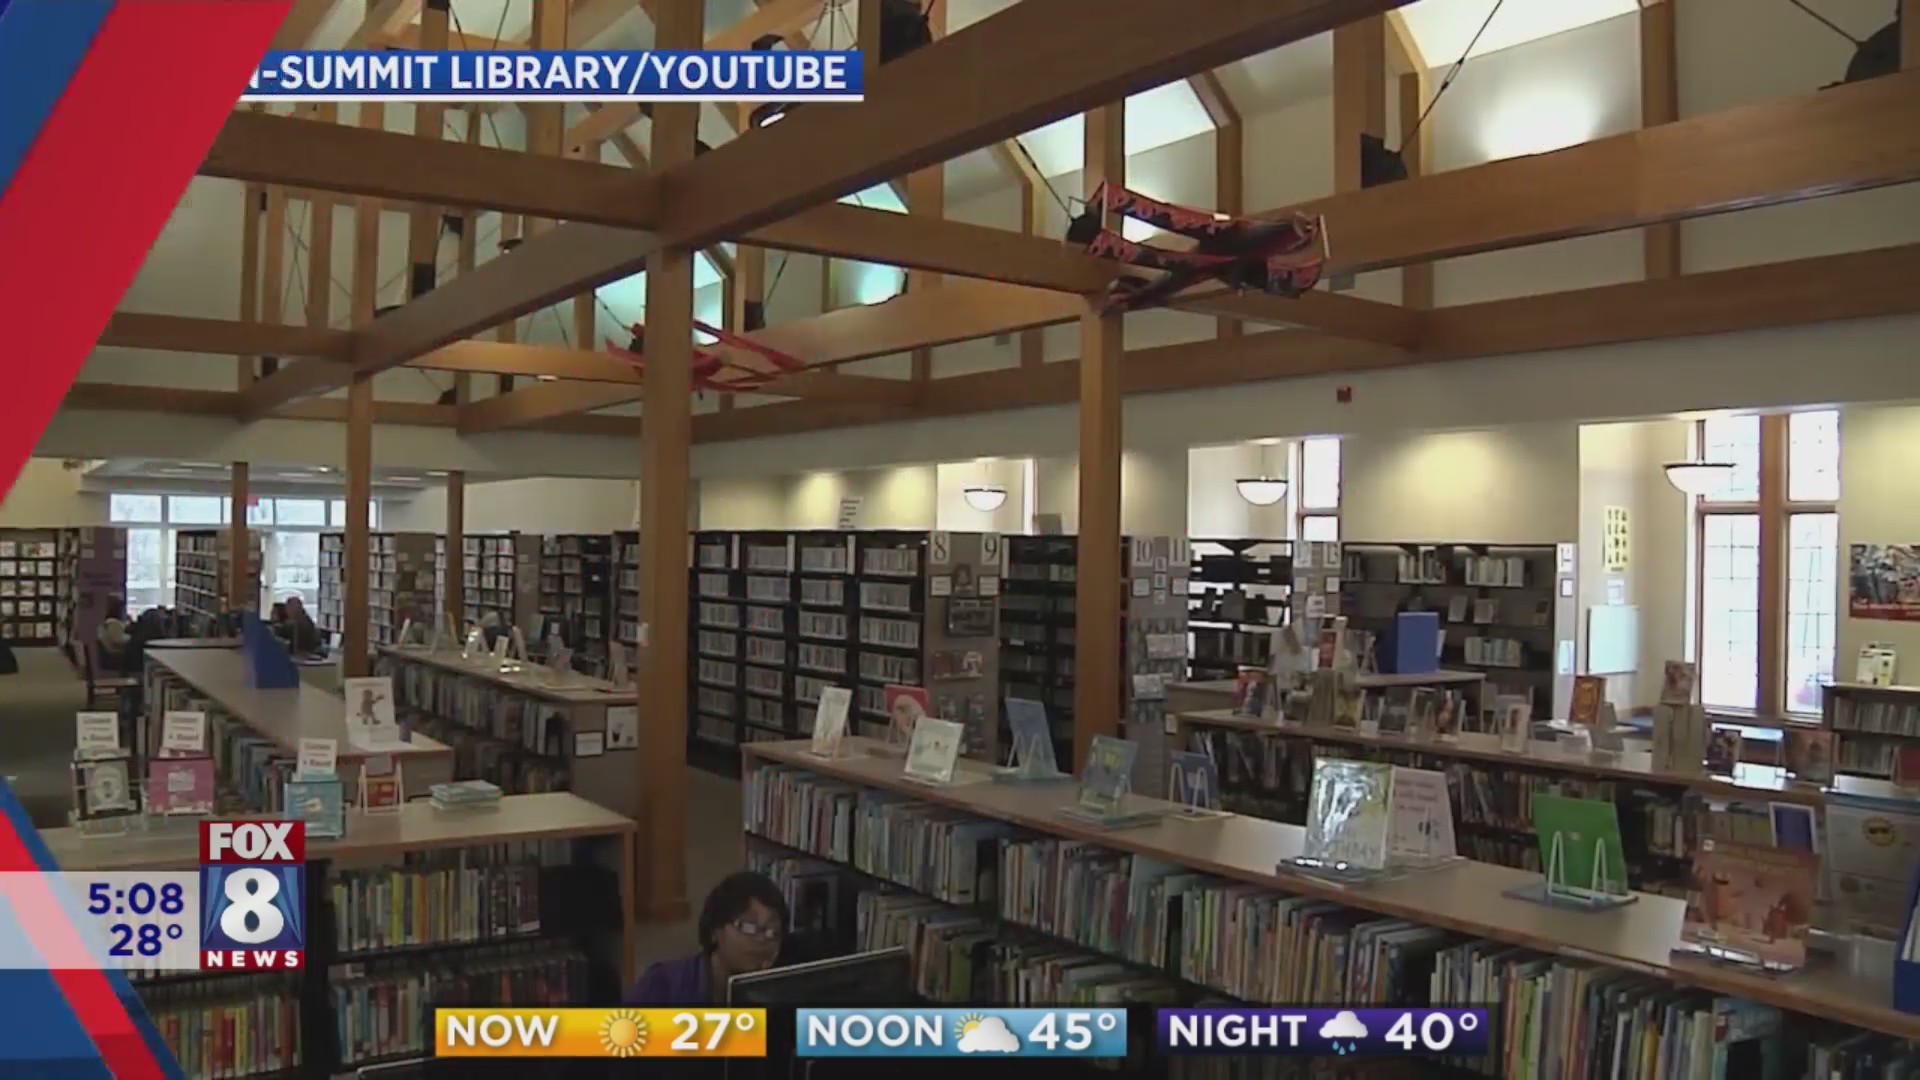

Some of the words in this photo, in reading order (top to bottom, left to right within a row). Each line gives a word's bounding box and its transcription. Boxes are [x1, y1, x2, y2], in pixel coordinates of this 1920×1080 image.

[933, 534, 947, 560] 8
[983, 537, 998, 562] 9
[1136, 539, 1153, 563] 10
[1172, 538, 1187, 563] 11
